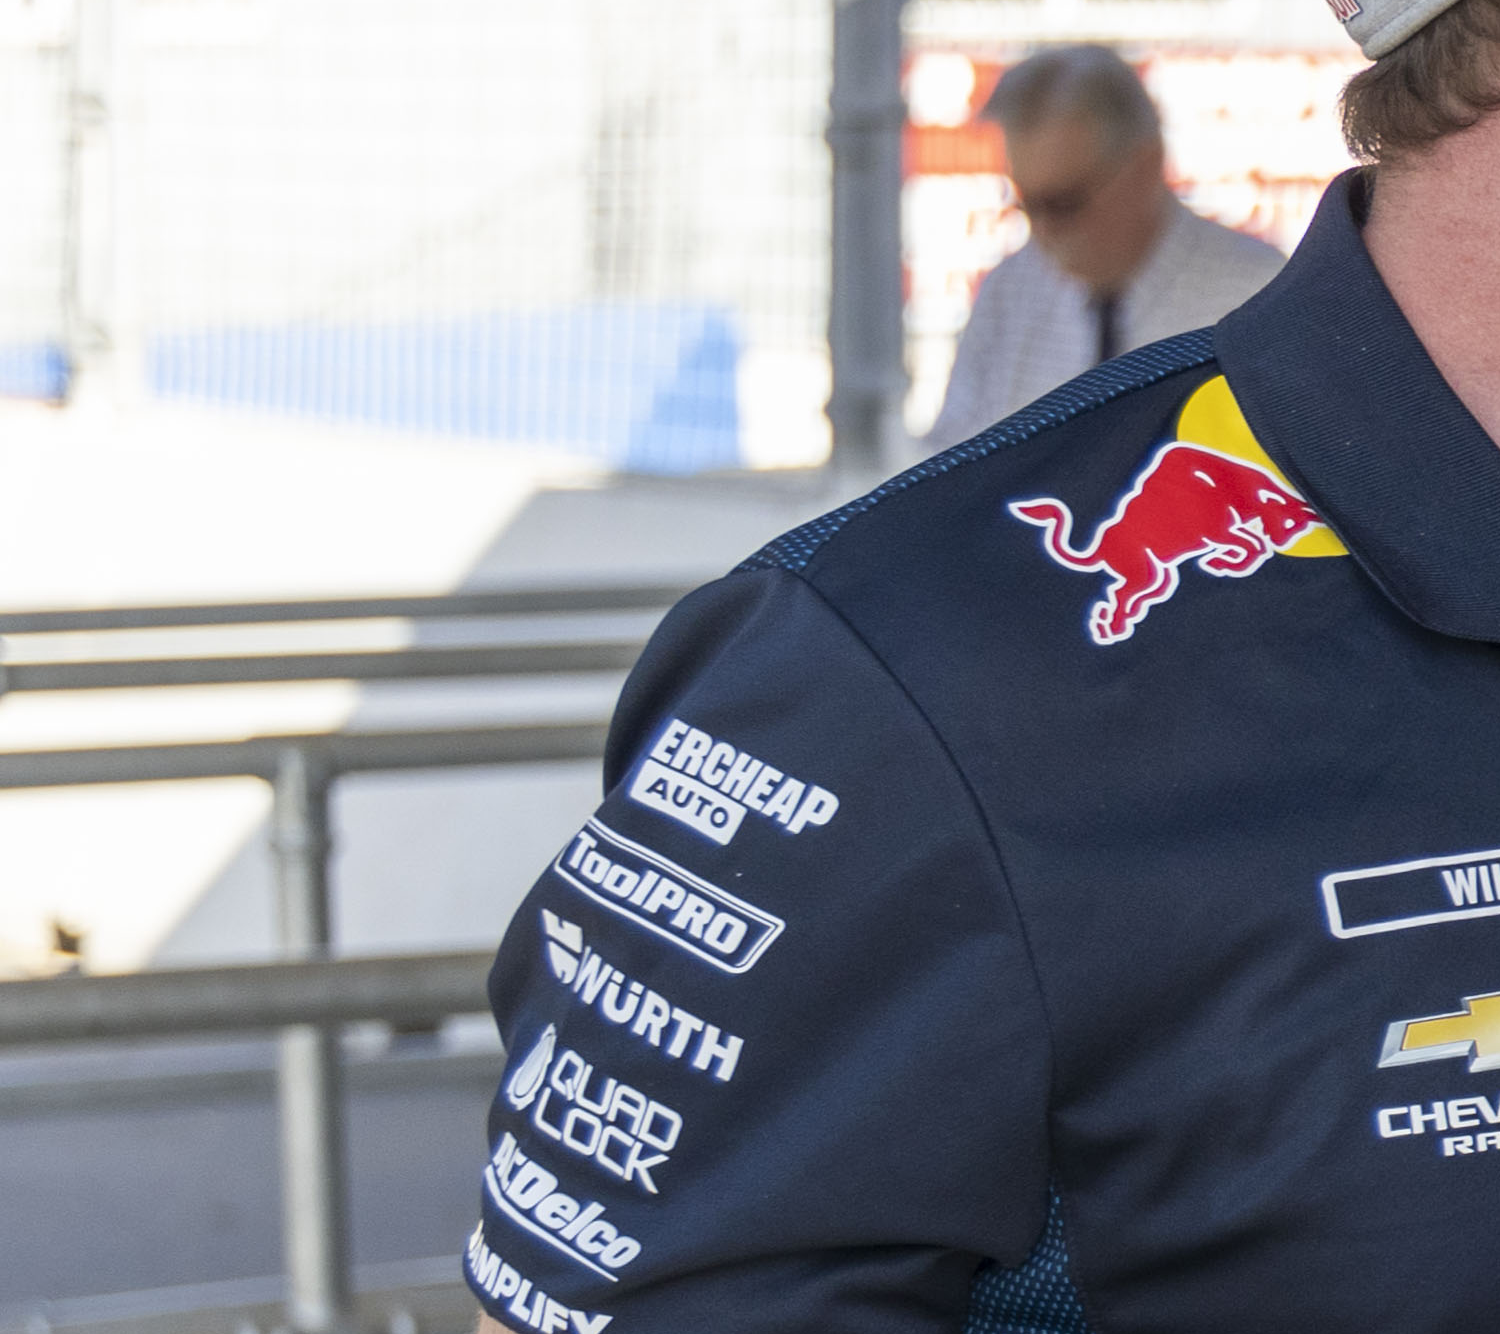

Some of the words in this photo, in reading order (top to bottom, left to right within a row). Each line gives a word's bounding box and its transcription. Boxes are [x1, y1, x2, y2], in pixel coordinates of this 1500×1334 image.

[645, 777, 730, 830] AUTO
[574, 945, 744, 1082] WÜRTH
[534, 1086, 670, 1194] LOCK
[551, 1049, 683, 1152] QUAD
